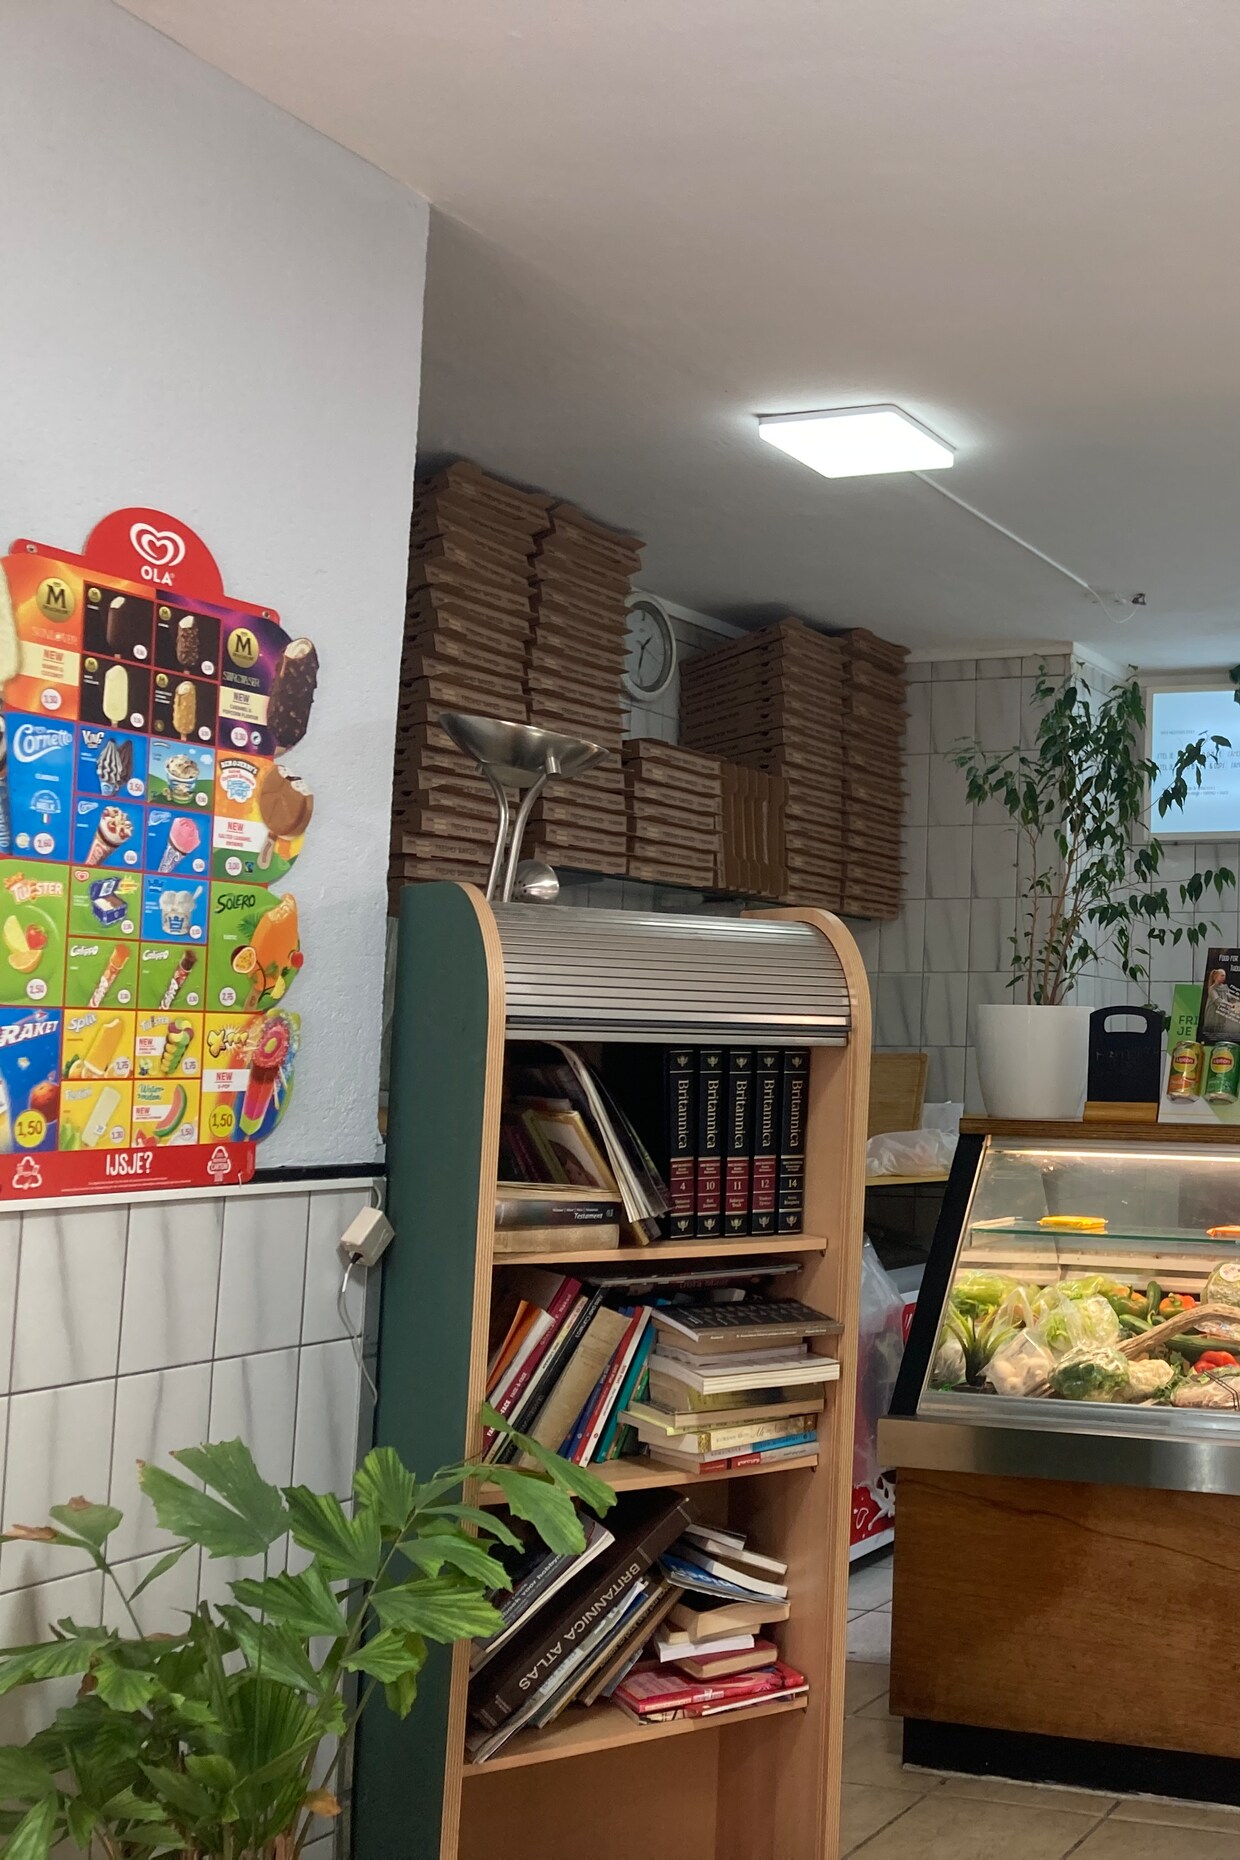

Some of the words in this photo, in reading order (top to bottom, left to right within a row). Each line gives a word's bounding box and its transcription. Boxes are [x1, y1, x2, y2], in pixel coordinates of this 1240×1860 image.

[140, 565, 173, 587] OLA
[43, 649, 64, 661] NEW
[233, 691, 250, 703] NEW
[13, 724, 73, 763] Cornetto
[228, 821, 244, 832] NEW
[215, 894, 256, 914] SOLERO
[1179, 1015, 1198, 1026] FRI
[0, 1021, 59, 1048] RAKET
[1177, 1026, 1192, 1036] JE
[139, 1038, 153, 1046] NEW
[216, 1071, 234, 1081] NEW
[135, 1106, 150, 1114] NEW
[678, 1080, 690, 1149] Britannica
[706, 1080, 720, 1149] Britannica
[734, 1080, 748, 1149] Britannica
[762, 1080, 775, 1147] Britannica
[790, 1080, 804, 1147] Britannica
[17, 1120, 43, 1137] 1,50
[212, 1113, 233, 1129] 1,50
[106, 1151, 153, 1176] IJSJE?
[680, 1182, 686, 1191] 4
[706, 1181, 716, 1191] 10
[733, 1181, 742, 1191] 11
[761, 1179, 770, 1188] 12
[788, 1179, 798, 1188] 14
[563, 1563, 641, 1641] BRITANNICA
[518, 1641, 563, 1691] ATLAS
